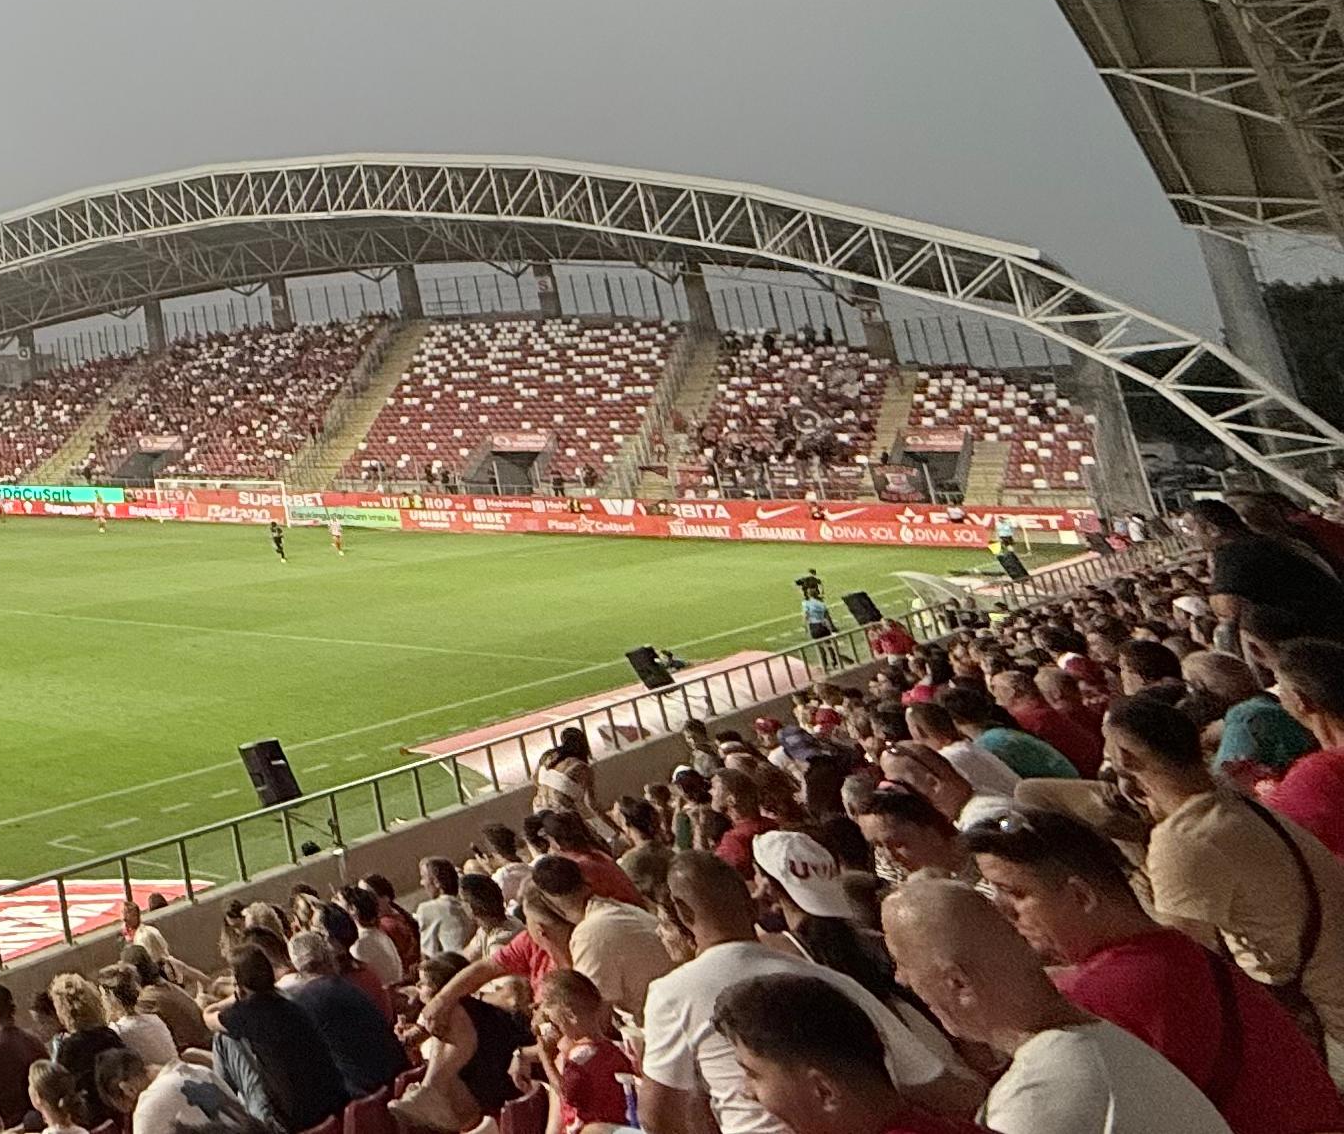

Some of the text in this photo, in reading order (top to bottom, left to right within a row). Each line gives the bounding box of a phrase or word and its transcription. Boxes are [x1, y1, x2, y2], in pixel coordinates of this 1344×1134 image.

[409, 510, 512, 524] UNIBET UNIBET
[833, 526, 897, 540] DIVA SOL
[915, 528, 982, 543] DIVA SOL
